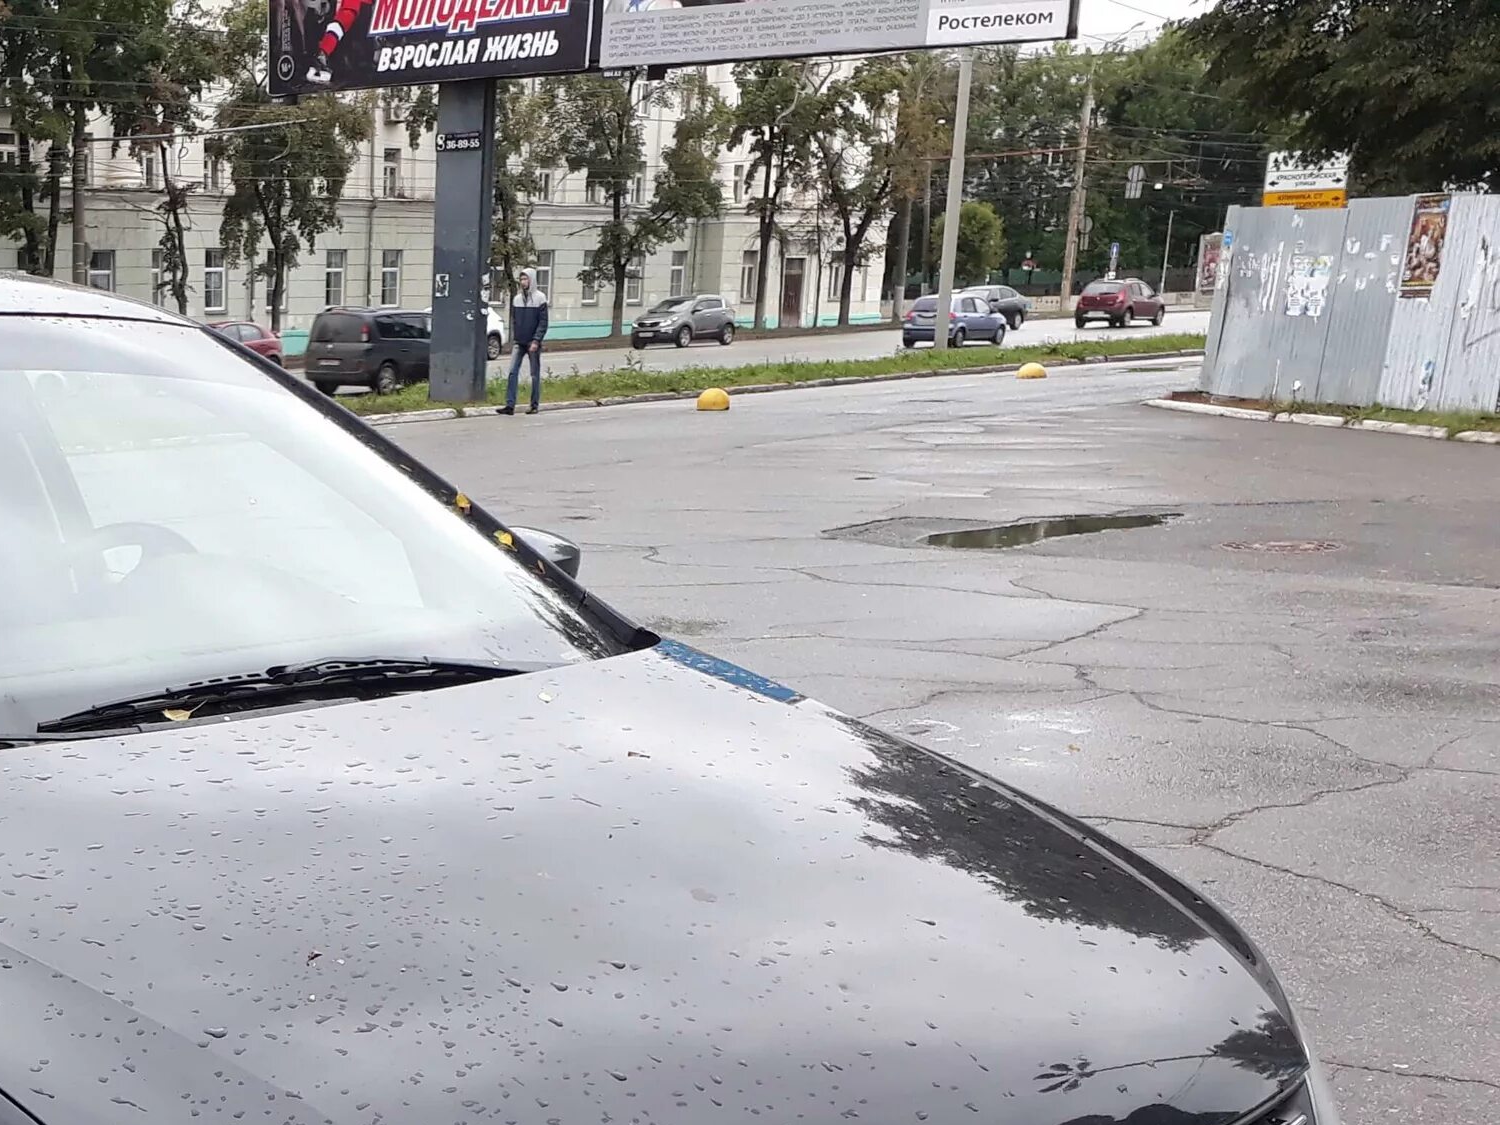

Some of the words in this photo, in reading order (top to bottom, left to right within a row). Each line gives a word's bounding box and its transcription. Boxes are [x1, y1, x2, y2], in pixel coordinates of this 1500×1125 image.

[939, 12, 1053, 30] Ростелеком
[377, 38, 480, 72] ВЗРОСЛАЯ
[482, 30, 559, 62] ЖИЗНЬ
[446, 138, 480, 149] 36-89-55
